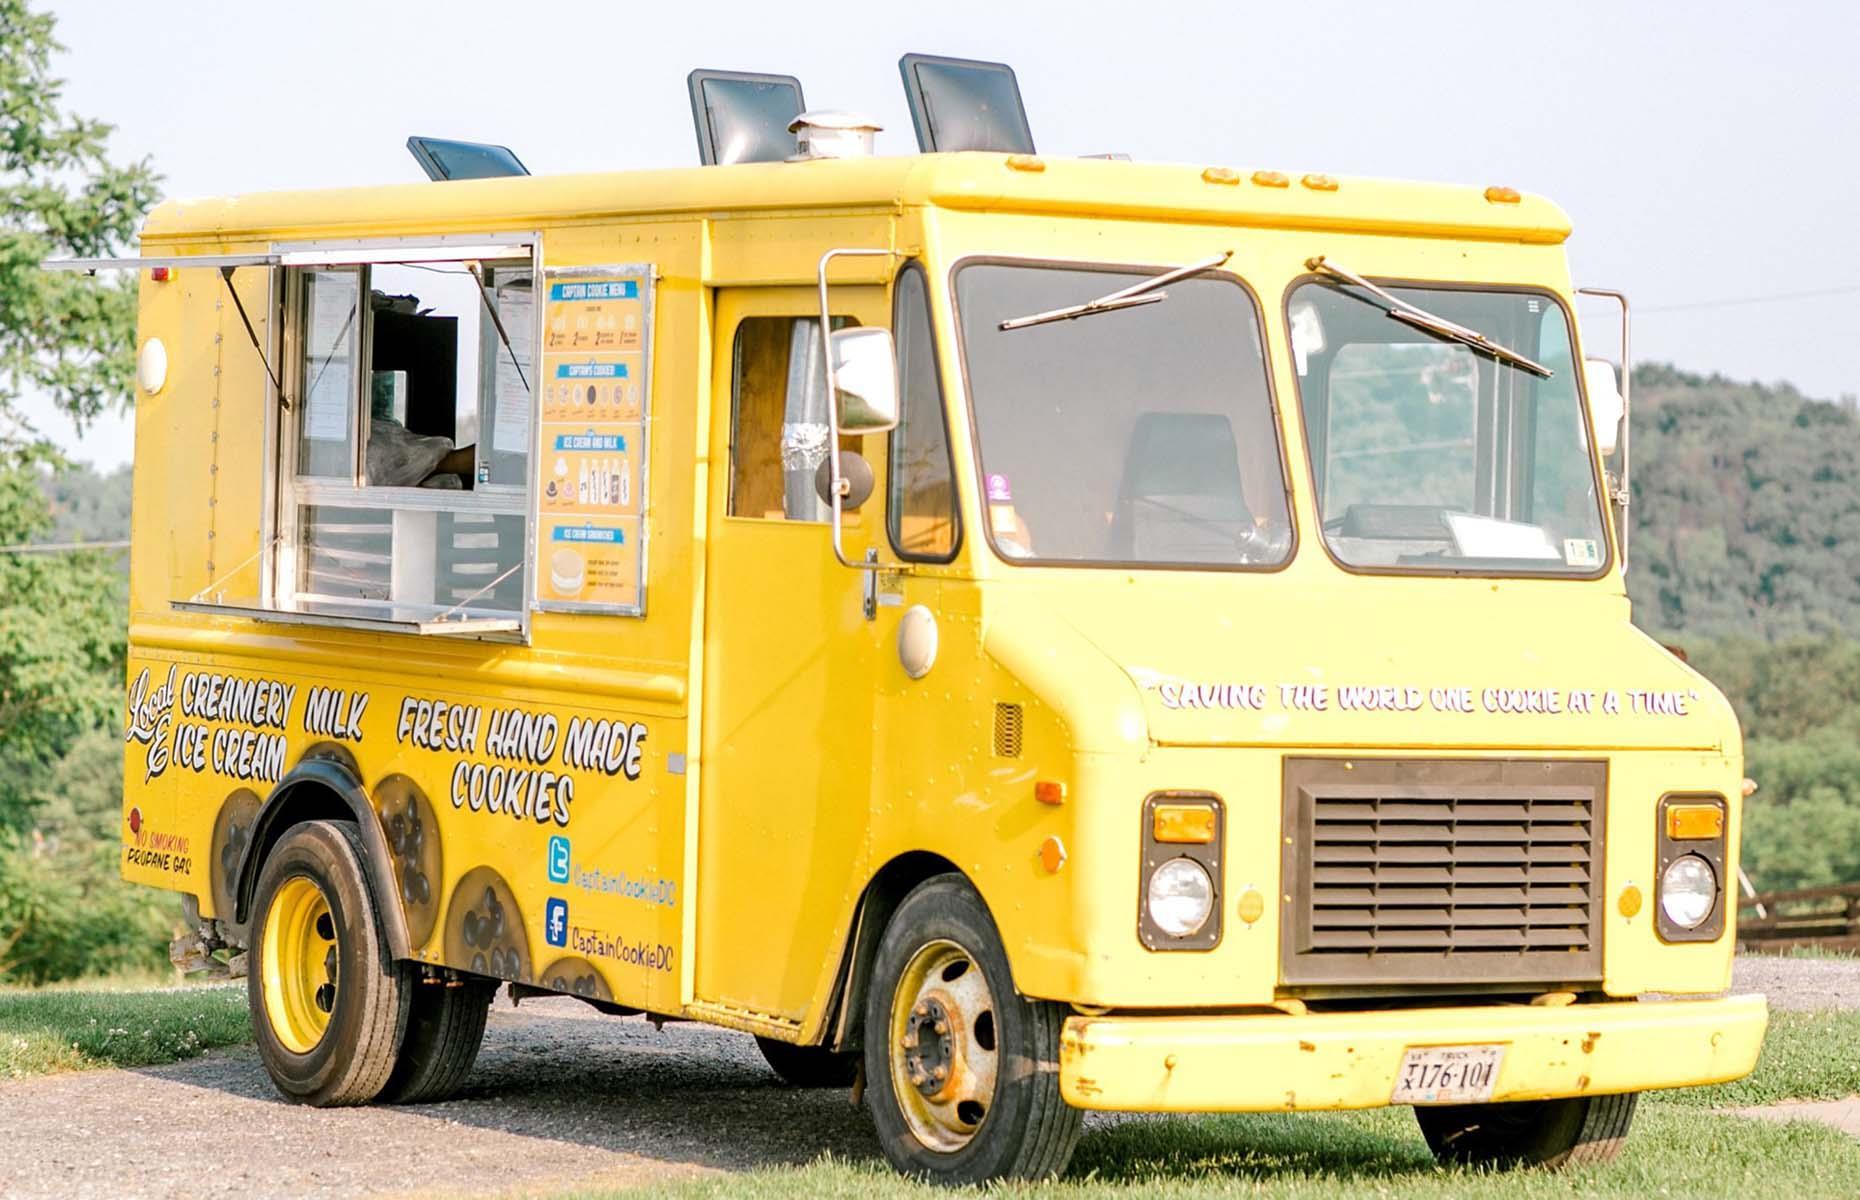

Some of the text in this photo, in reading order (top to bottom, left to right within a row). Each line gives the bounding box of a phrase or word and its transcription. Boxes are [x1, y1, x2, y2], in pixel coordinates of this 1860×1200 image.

[126, 663, 369, 744] Local CREAMERY MILK
[1277, 684, 1328, 711] THE
[1337, 685, 1424, 711] WORLD
[1429, 687, 1475, 713] ONE
[1482, 687, 1562, 714] COOKIE
[1567, 689, 1595, 715] AT
[1602, 690, 1619, 714] A
[172, 721, 209, 772] ICE
[212, 728, 287, 785] CREAM
[397, 696, 648, 780] FRESH HAND MADE
[451, 760, 574, 827] COOKIES
[127, 848, 192, 875] PROPANE GAS
[135, 830, 190, 854] NO SMOKING
[573, 863, 677, 908] CaptainCookieDC
[572, 926, 675, 972] CaptainCookieDC
